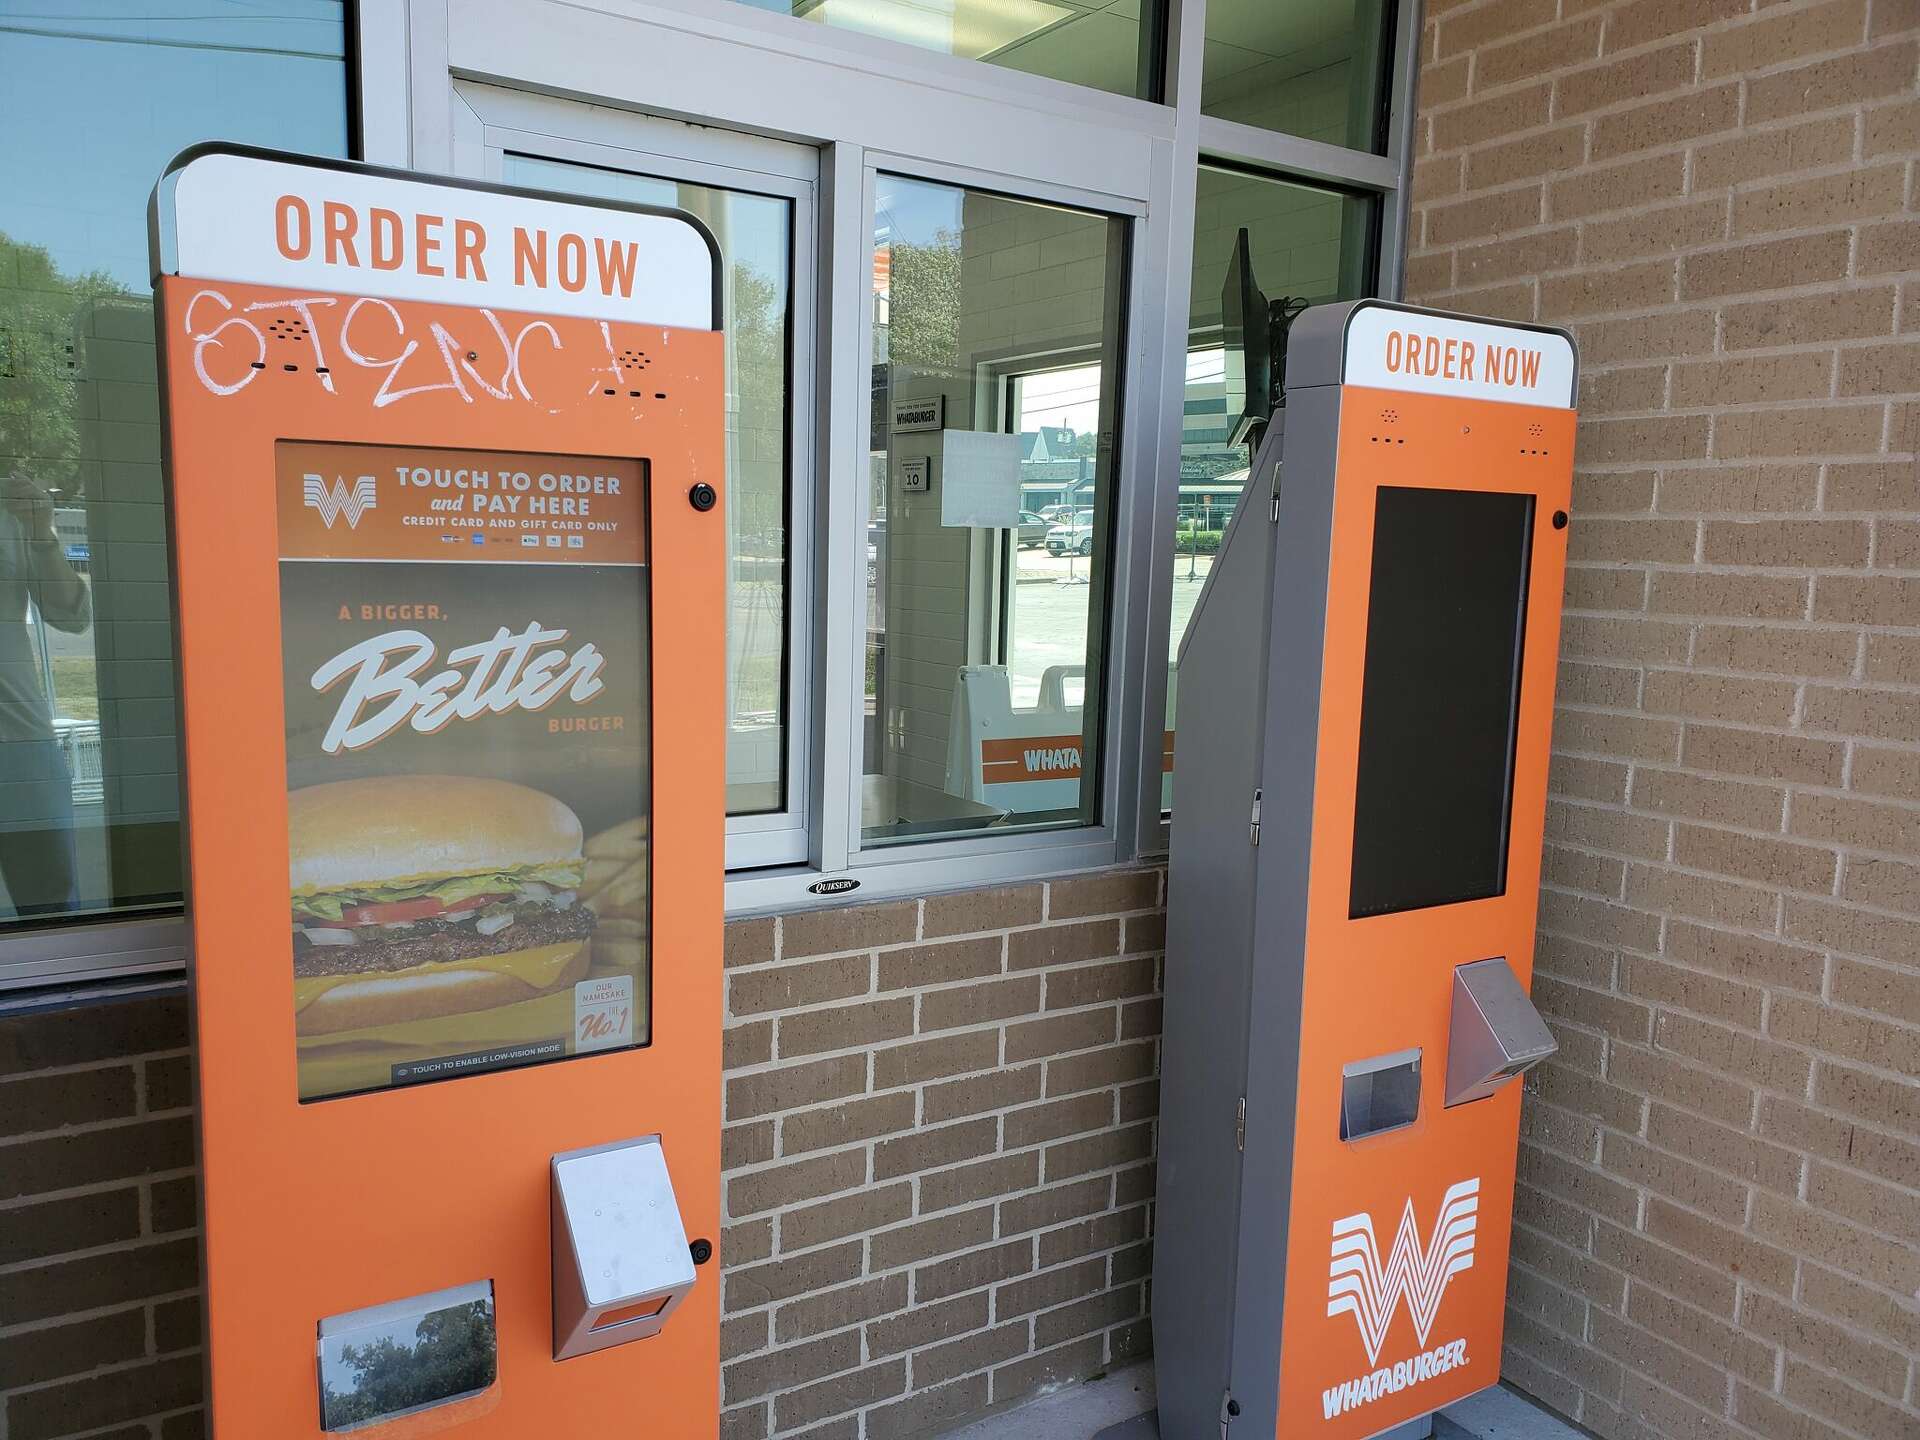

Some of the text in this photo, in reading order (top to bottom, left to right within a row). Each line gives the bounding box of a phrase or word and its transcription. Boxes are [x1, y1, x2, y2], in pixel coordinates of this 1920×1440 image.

[275, 194, 639, 298] ORDER NOW
[1386, 331, 1541, 388] ORDER NOW
[396, 467, 622, 494] TOUCH TO ORDER
[906, 474, 920, 486] 10
[431, 494, 590, 515] and PAY HERE
[402, 516, 618, 531] CREDIT CARD AND GIFT CARD ONLY
[338, 605, 449, 621] A BIGGER,
[311, 620, 608, 755] Better
[548, 716, 624, 732] BURGER
[1023, 747, 1081, 772] WHATA
[815, 880, 853, 894] QUIKSERV
[582, 989, 625, 1001] NAMESAKE
[596, 982, 613, 991] OUR
[413, 1063, 441, 1074] TOUCH
[455, 1056, 488, 1068] ENABLE
[489, 1050, 536, 1062] LOW-VISION
[537, 1044, 561, 1054] MODE
[1322, 1338, 1467, 1420] WHATABURGER
